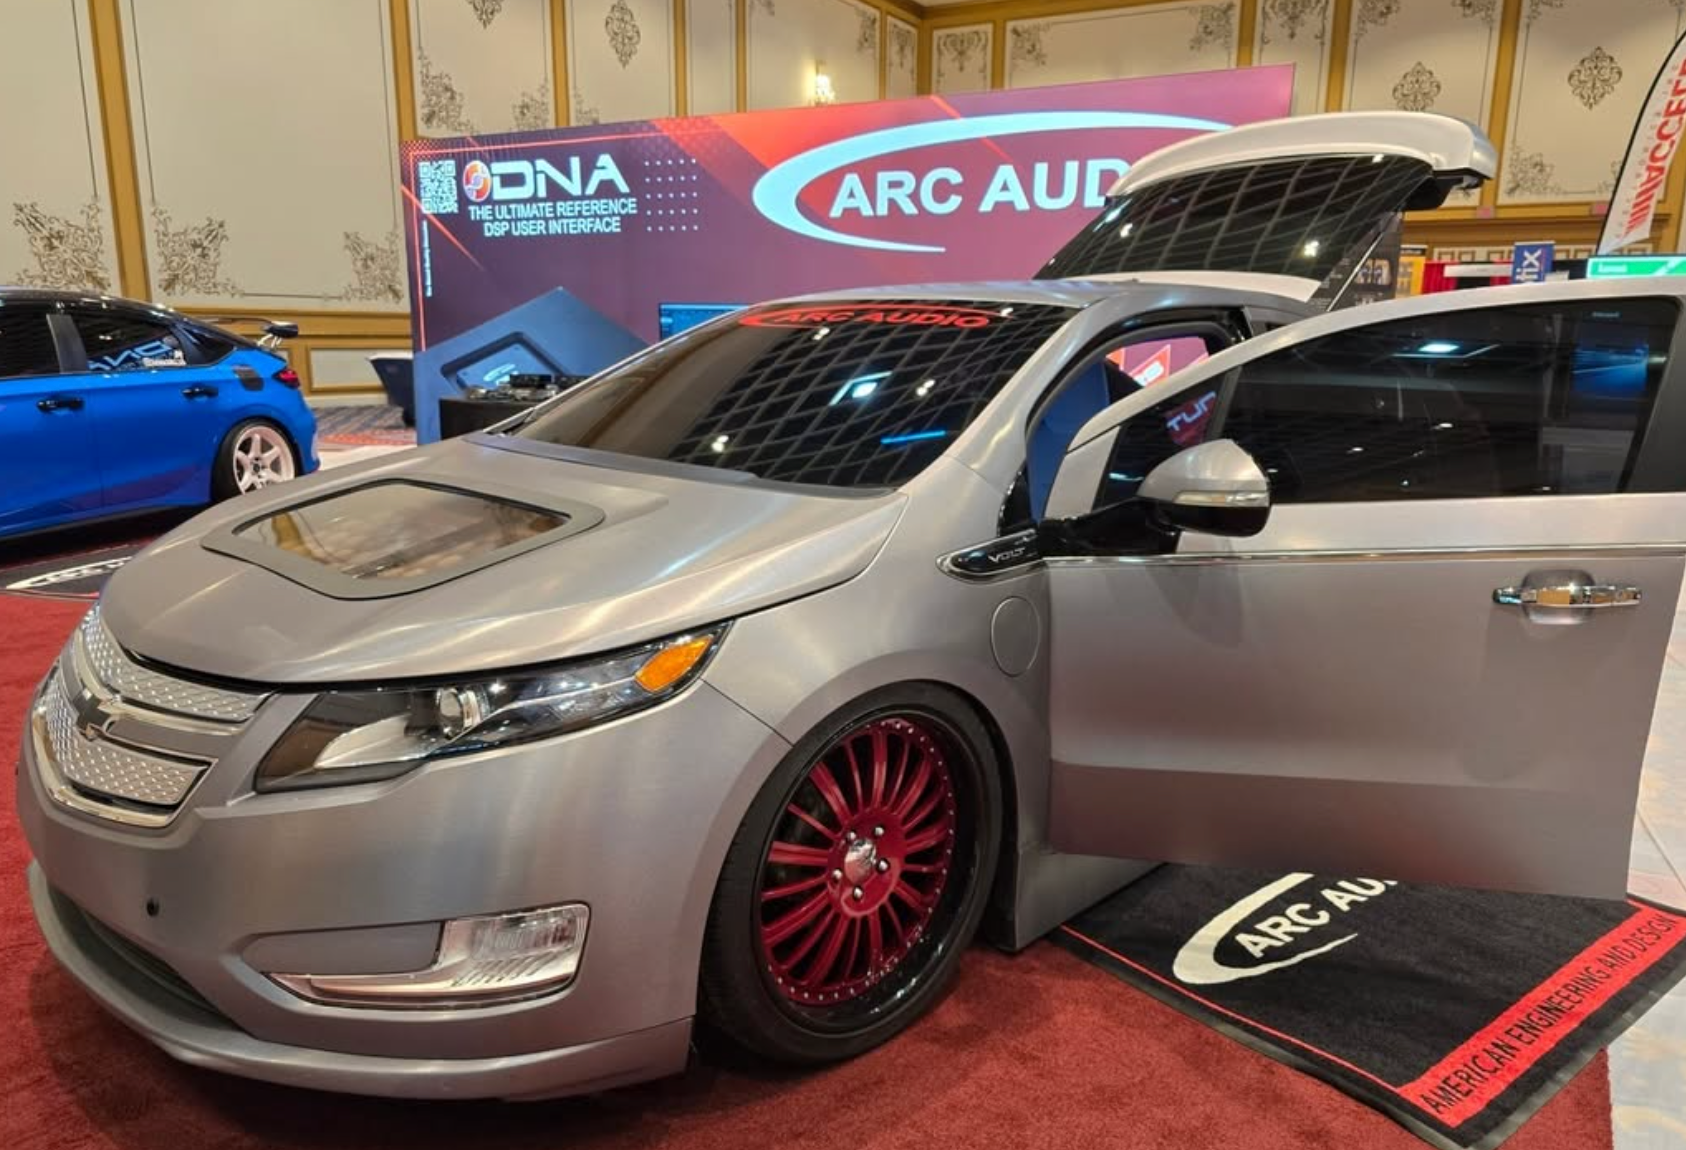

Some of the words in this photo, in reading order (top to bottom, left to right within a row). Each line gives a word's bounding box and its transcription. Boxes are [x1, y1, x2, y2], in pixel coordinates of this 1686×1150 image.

[490, 153, 630, 200] DNA
[828, 167, 964, 218] ARC
[468, 205, 494, 221] THE
[494, 201, 554, 220] ULTIMATE
[556, 198, 638, 217] REFERENCE
[483, 221, 510, 237] DSP
[511, 219, 547, 236] USER
[548, 217, 622, 234] INTERFACE
[775, 311, 854, 323] ARC
[861, 311, 989, 328] AUDIO
[1234, 902, 1331, 959] ARC
[1320, 877, 1398, 912] AU
[1420, 1036, 1522, 1115] AMERICAN
[1504, 965, 1612, 1045] ENGINEERING
[1595, 943, 1637, 970] AND
[1622, 912, 1678, 953] DESIGN
